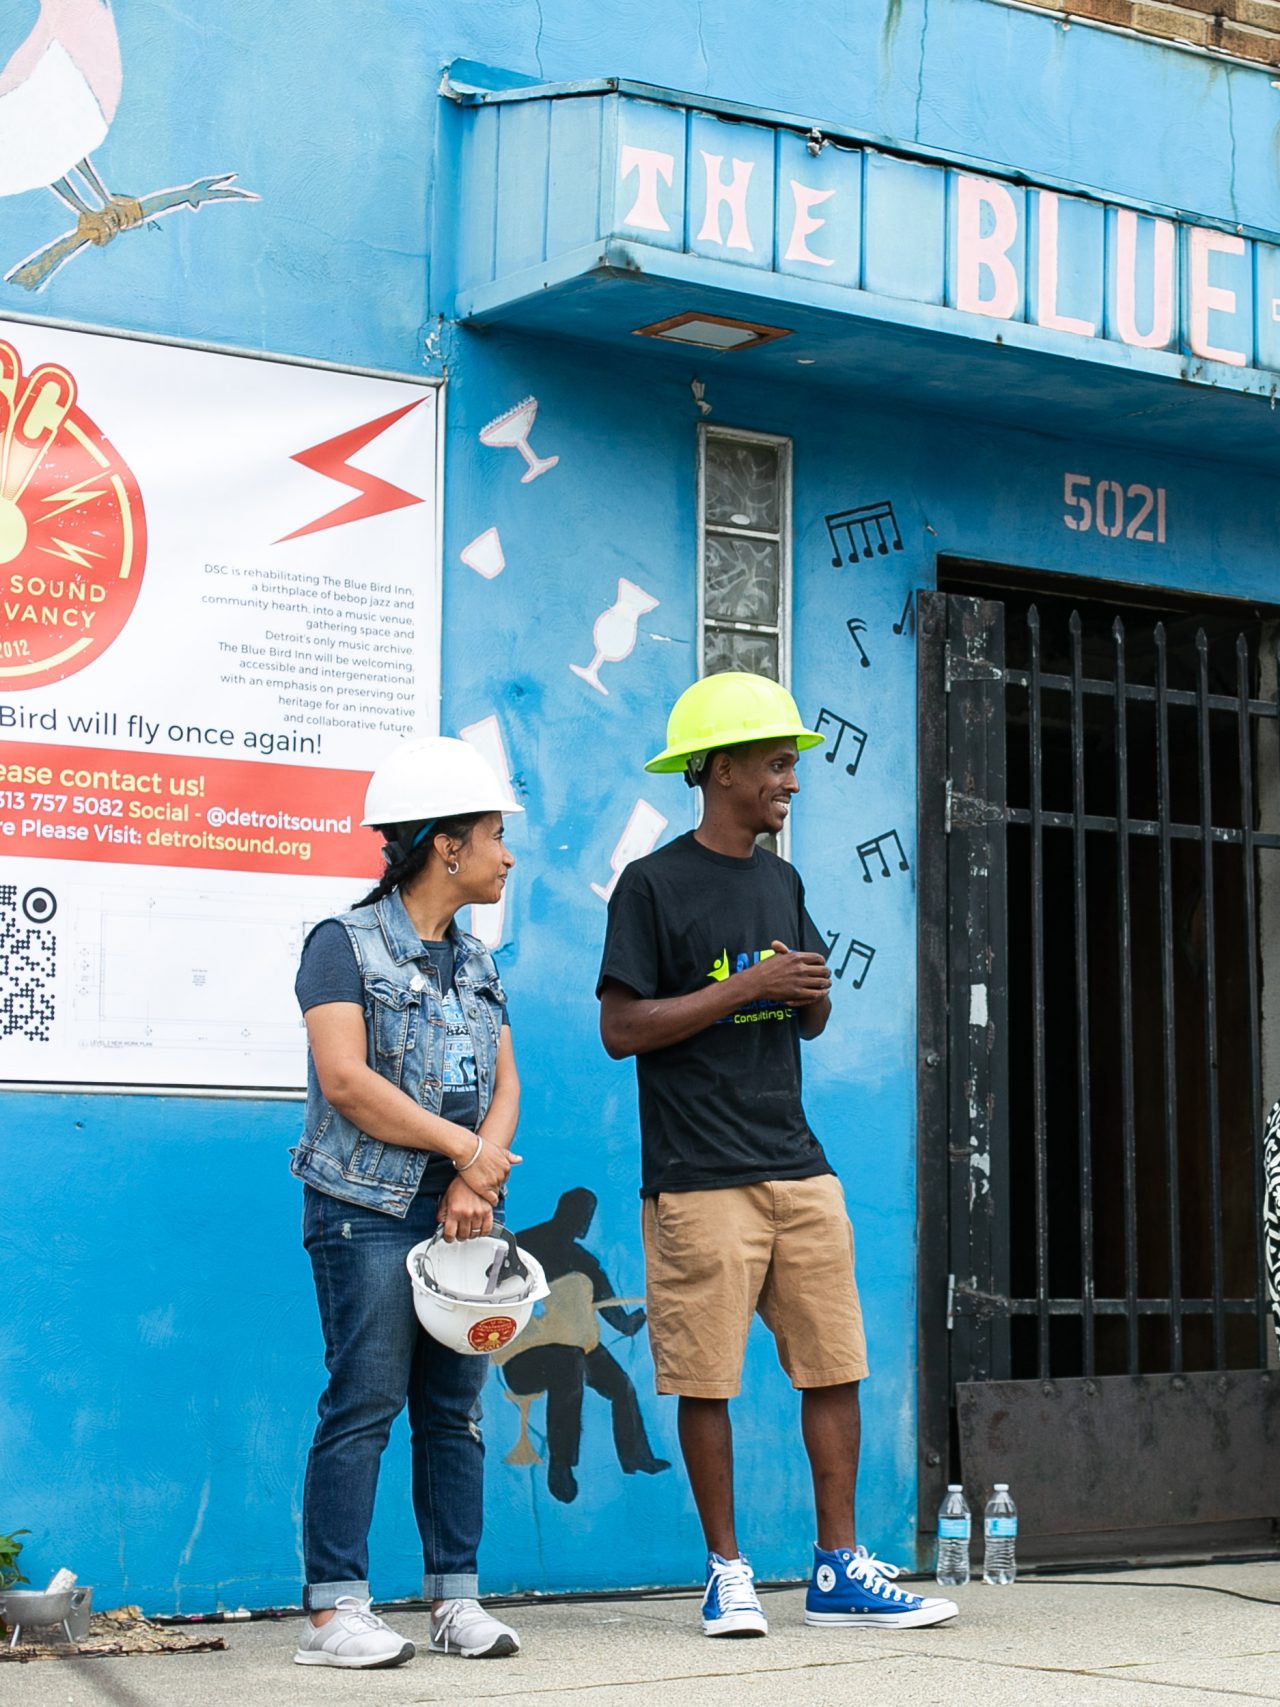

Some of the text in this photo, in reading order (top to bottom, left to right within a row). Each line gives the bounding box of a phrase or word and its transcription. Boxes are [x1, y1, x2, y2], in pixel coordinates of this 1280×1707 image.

[620, 144, 836, 266] THE
[1064, 472, 1166, 544] 5021
[10, 575, 106, 602] SOUND
[204, 564, 228, 575] DSC
[232, 568, 240, 576] is
[244, 568, 320, 586] rehabilitating
[323, 576, 341, 586] The
[344, 578, 367, 590] Blue
[370, 582, 391, 593] Bird
[202, 595, 269, 611] community
[313, 605, 334, 616] into
[346, 611, 376, 621] music
[262, 583, 318, 597] birthplace
[321, 590, 331, 599] of
[334, 592, 367, 606] bebop
[370, 596, 390, 607] jazz
[394, 600, 414, 609] and
[4, 602, 96, 628] VANCY
[265, 630, 311, 644] Detroit's
[314, 638, 336, 649] only
[339, 640, 370, 651] music
[306, 620, 414, 639] gathering space and
[0, 639, 30, 658] 012
[218, 642, 238, 652] The
[241, 644, 266, 655] Blue
[270, 647, 291, 658] Bird
[295, 650, 312, 660] Inn
[314, 653, 333, 663] will
[336, 655, 349, 664] be
[240, 660, 414, 684] accessible and intergenerational
[220, 675, 246, 684] with
[266, 678, 317, 692] emphasis
[337, 686, 393, 701] preserving
[397, 692, 414, 700] our
[279, 696, 322, 710] heritage
[325, 700, 339, 710] for
[360, 703, 415, 717] innovative
[0, 705, 322, 755] Bird will fly once again!
[284, 714, 415, 733] and collaborative future.
[59, 768, 162, 794] contact
[169, 775, 205, 797] us!
[30, 793, 68, 813] 757
[72, 796, 124, 818] 5082
[128, 800, 189, 822] Social
[206, 806, 352, 834] @detroitsound
[21, 819, 89, 841] Please
[93, 823, 142, 845] Visit:
[146, 828, 311, 860] detroitsound.org
